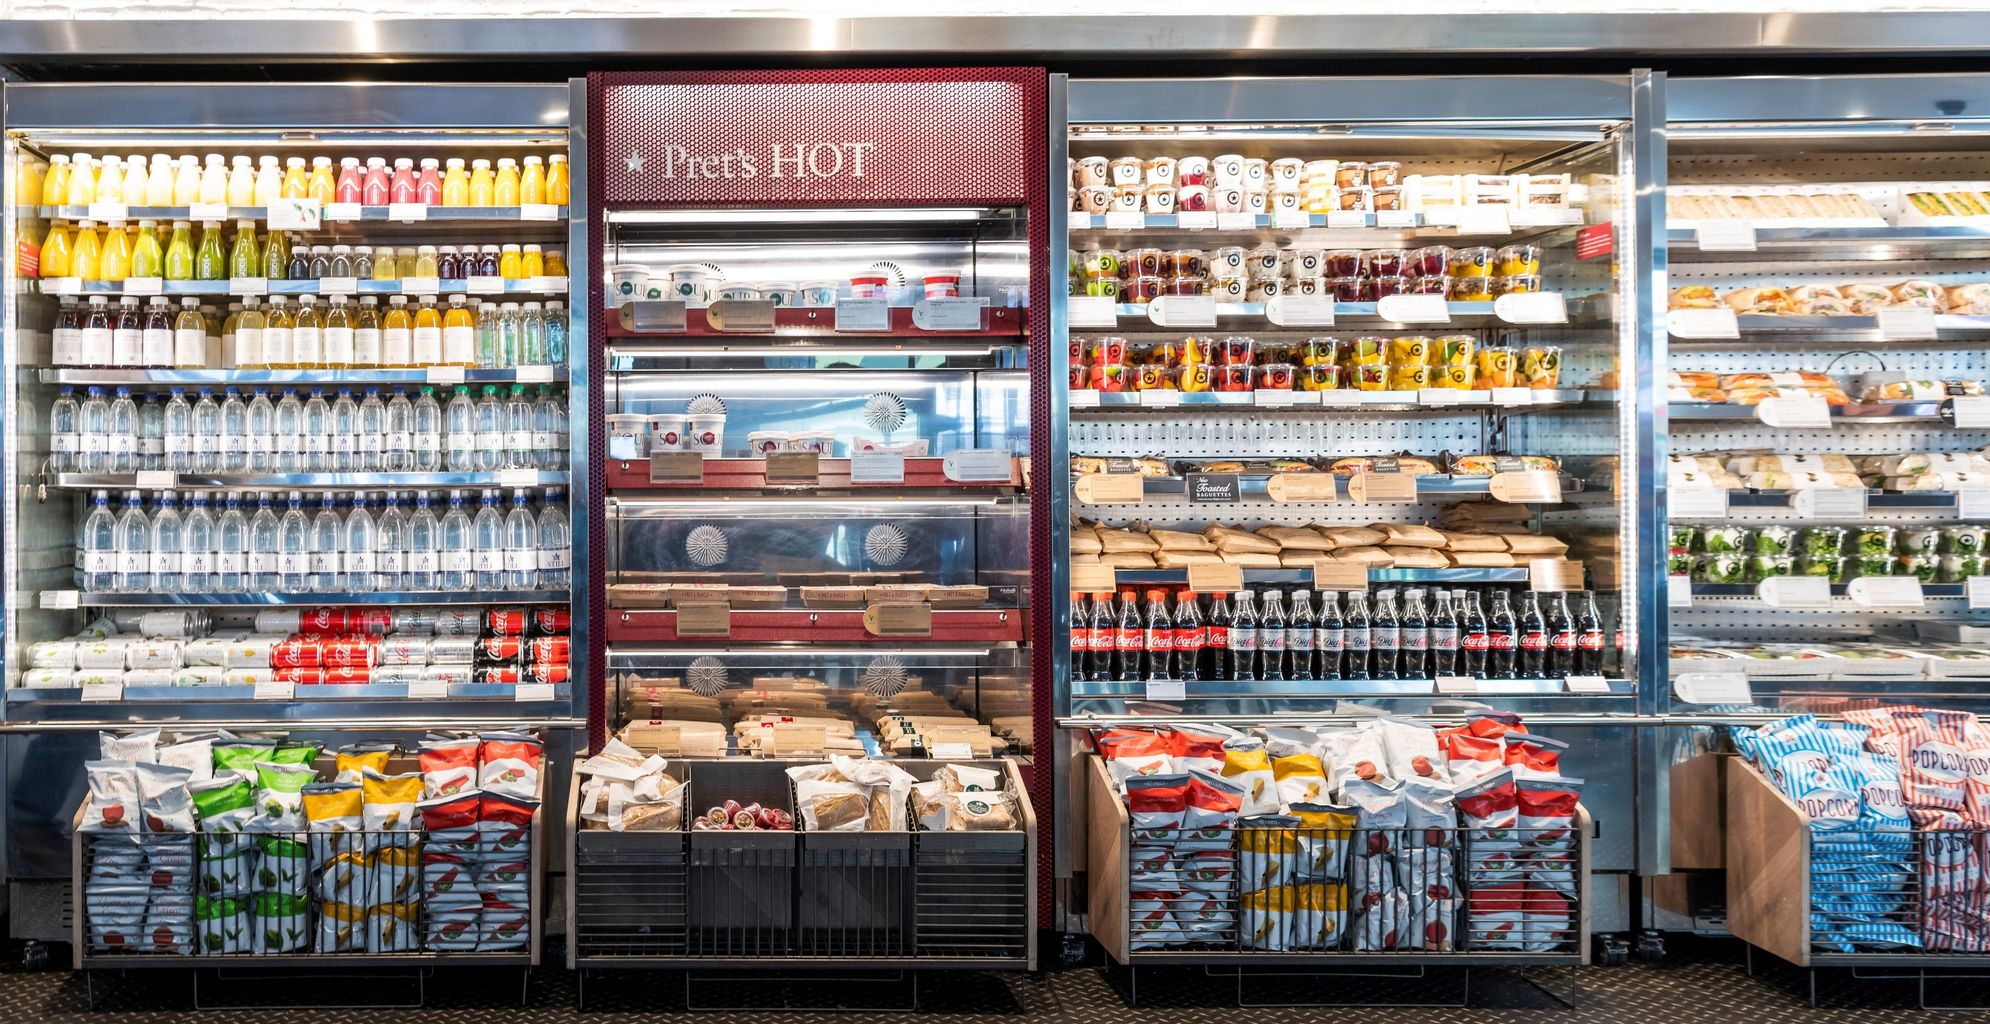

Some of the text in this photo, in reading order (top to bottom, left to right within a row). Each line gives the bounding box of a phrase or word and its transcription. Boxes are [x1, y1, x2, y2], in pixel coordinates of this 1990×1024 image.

[662, 143, 874, 179] Pret's HOT
[659, 432, 683, 446] SOU
[1196, 482, 1231, 492] Toasted
[1861, 787, 1904, 807] POPCO
